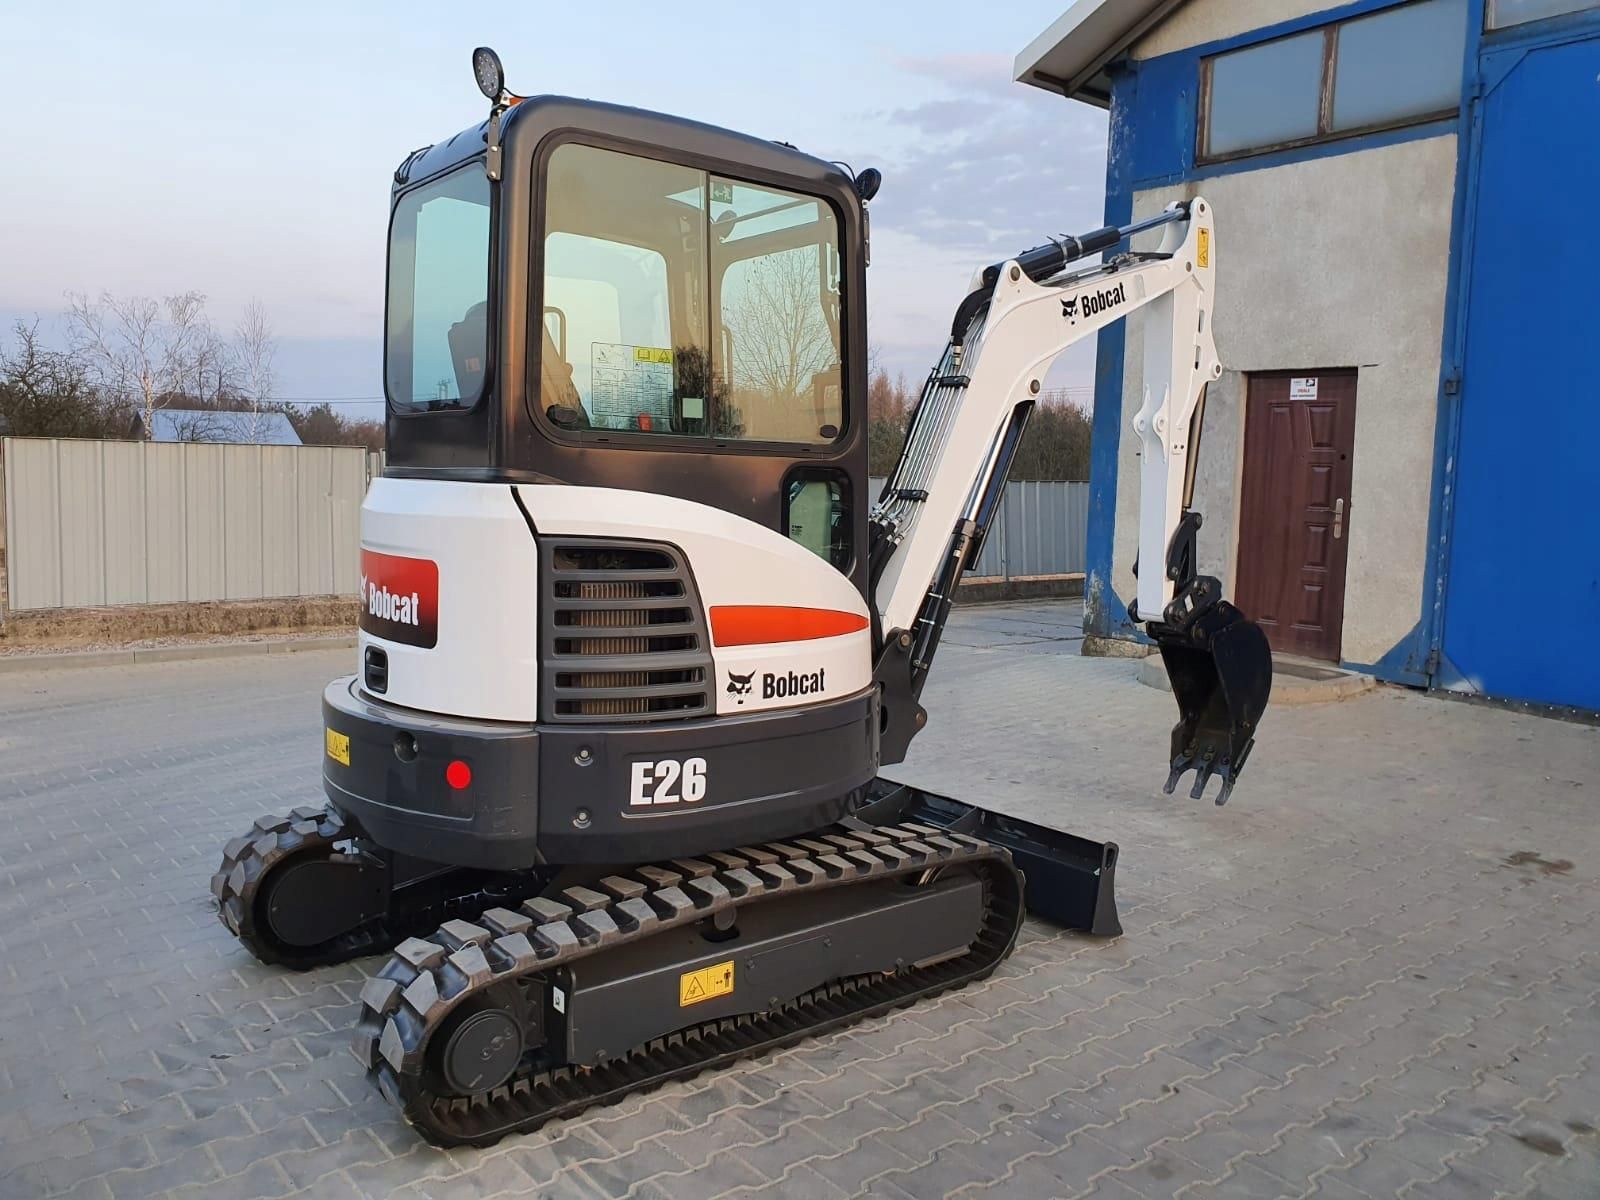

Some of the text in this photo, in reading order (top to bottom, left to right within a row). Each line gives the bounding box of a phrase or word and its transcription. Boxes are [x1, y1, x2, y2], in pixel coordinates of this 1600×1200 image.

[1081, 282, 1126, 318] Bobcat
[369, 582, 419, 626] Bobcat
[762, 668, 825, 699] Bobcat
[630, 757, 707, 805] E26
